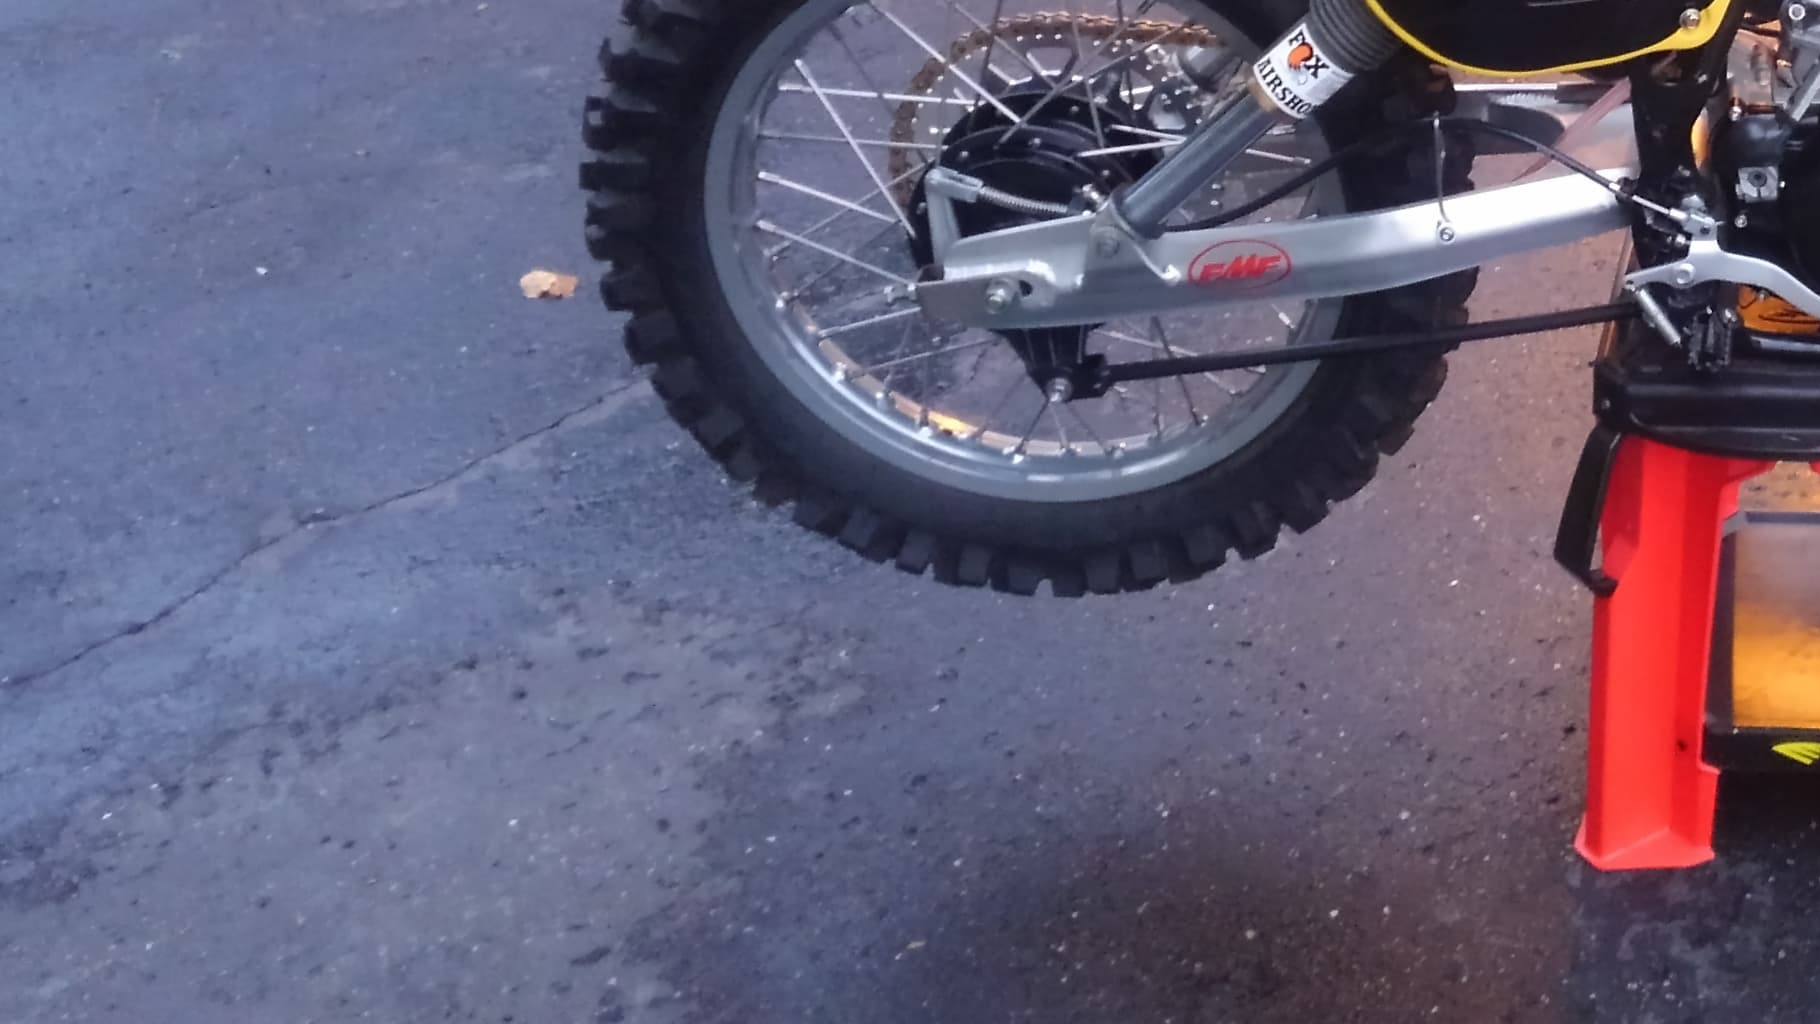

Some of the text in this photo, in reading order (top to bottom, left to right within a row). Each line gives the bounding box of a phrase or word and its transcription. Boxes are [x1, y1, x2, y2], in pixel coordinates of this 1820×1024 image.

[1288, 29, 1330, 79] FOX
[1257, 57, 1318, 115] AIRSHO
[1199, 253, 1281, 282] FMF
